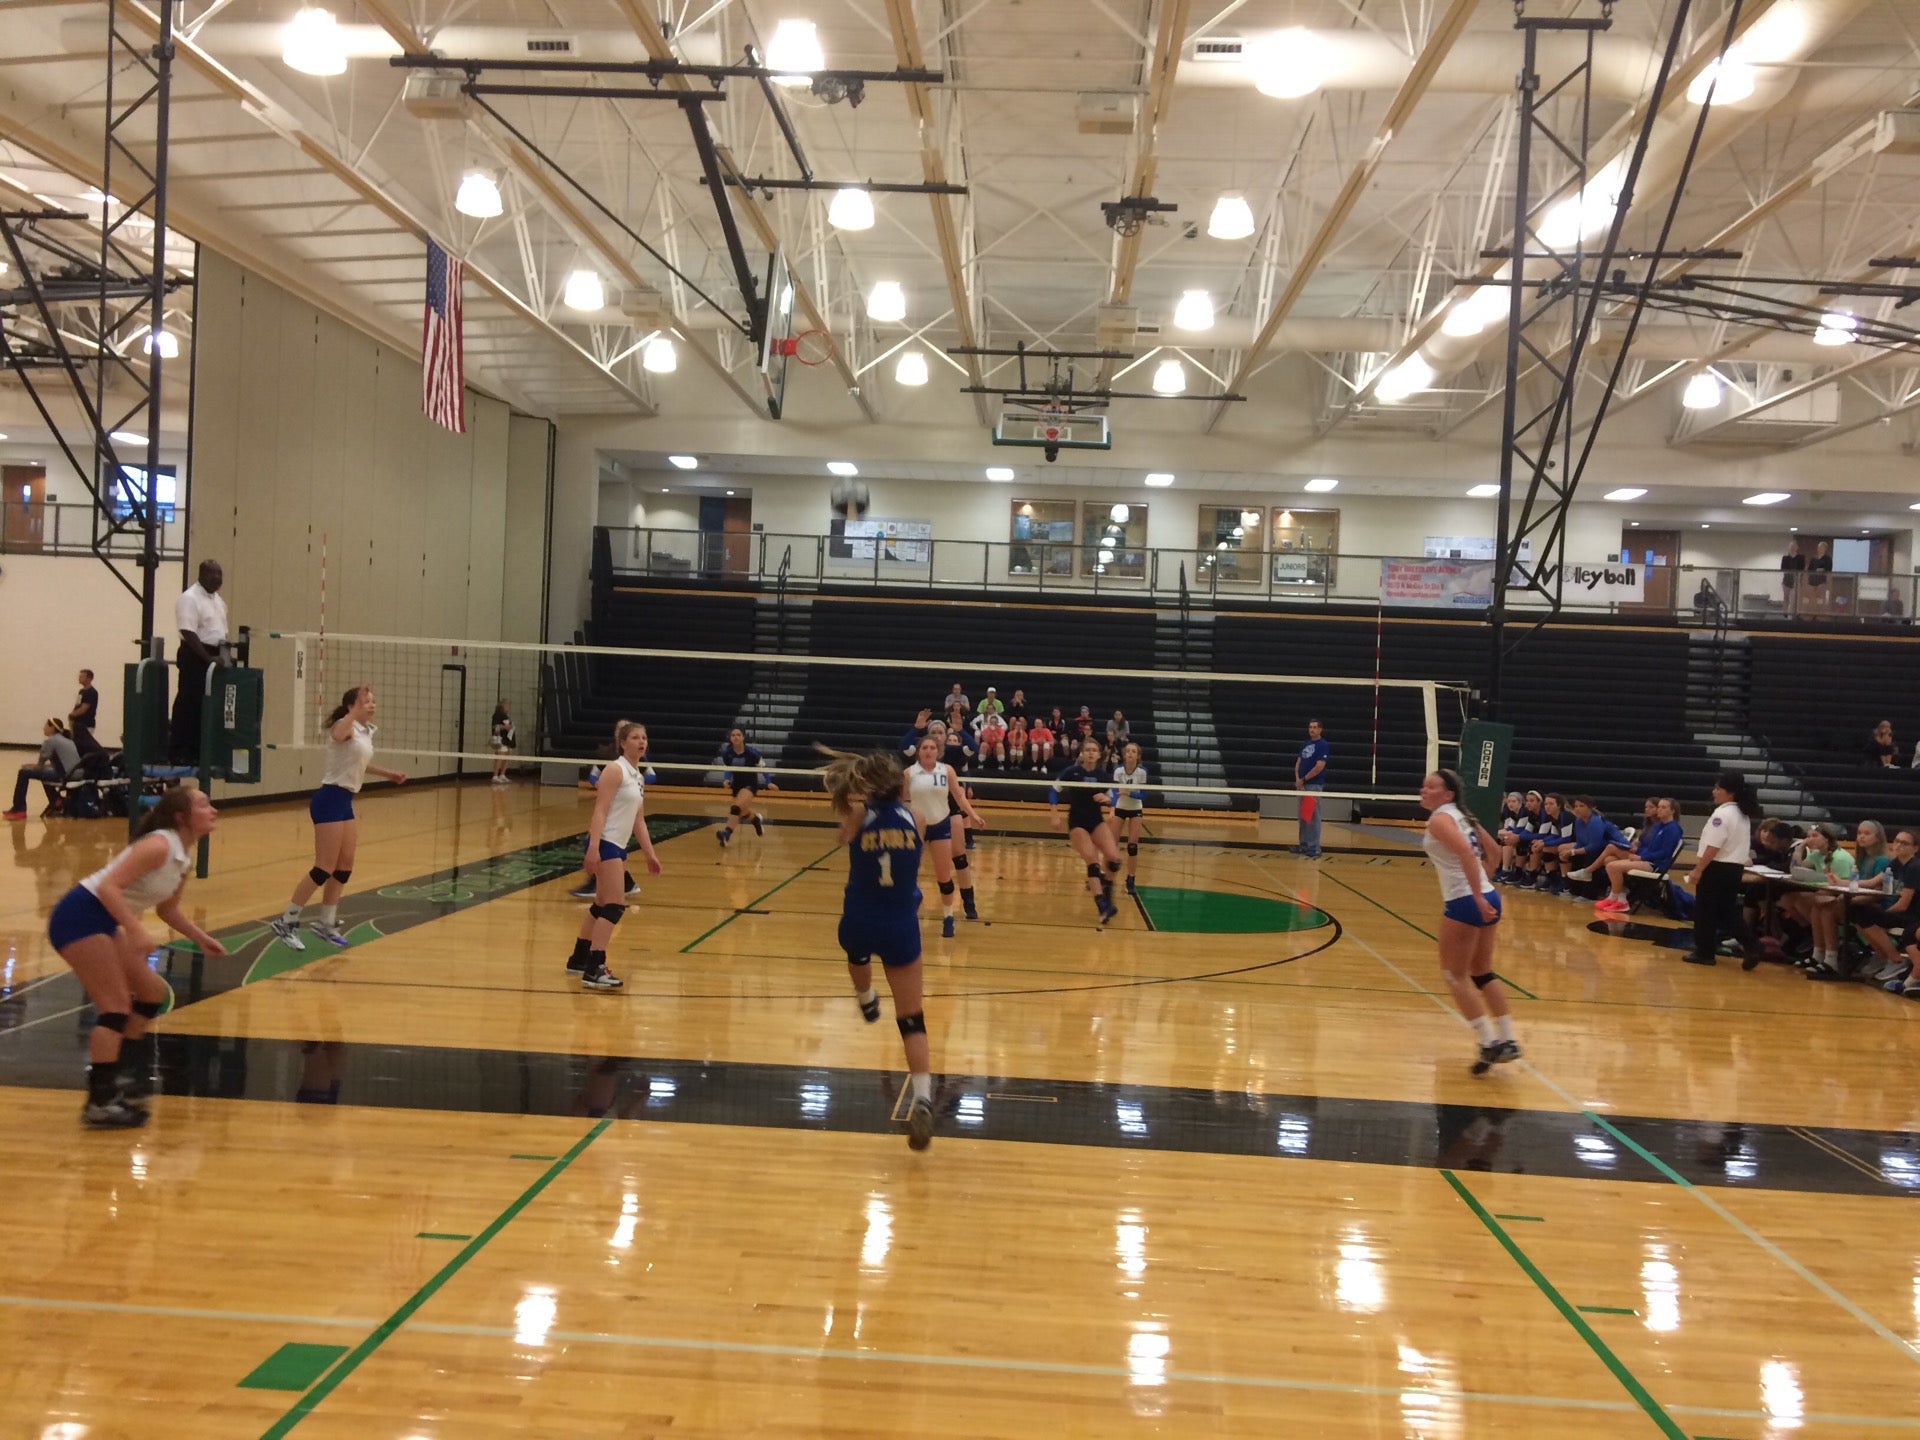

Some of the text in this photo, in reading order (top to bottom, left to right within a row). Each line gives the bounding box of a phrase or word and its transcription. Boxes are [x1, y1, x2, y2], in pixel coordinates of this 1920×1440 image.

[1480, 742, 1493, 780] PORTER
[933, 773, 947, 786] 10
[877, 851, 895, 887] 1
